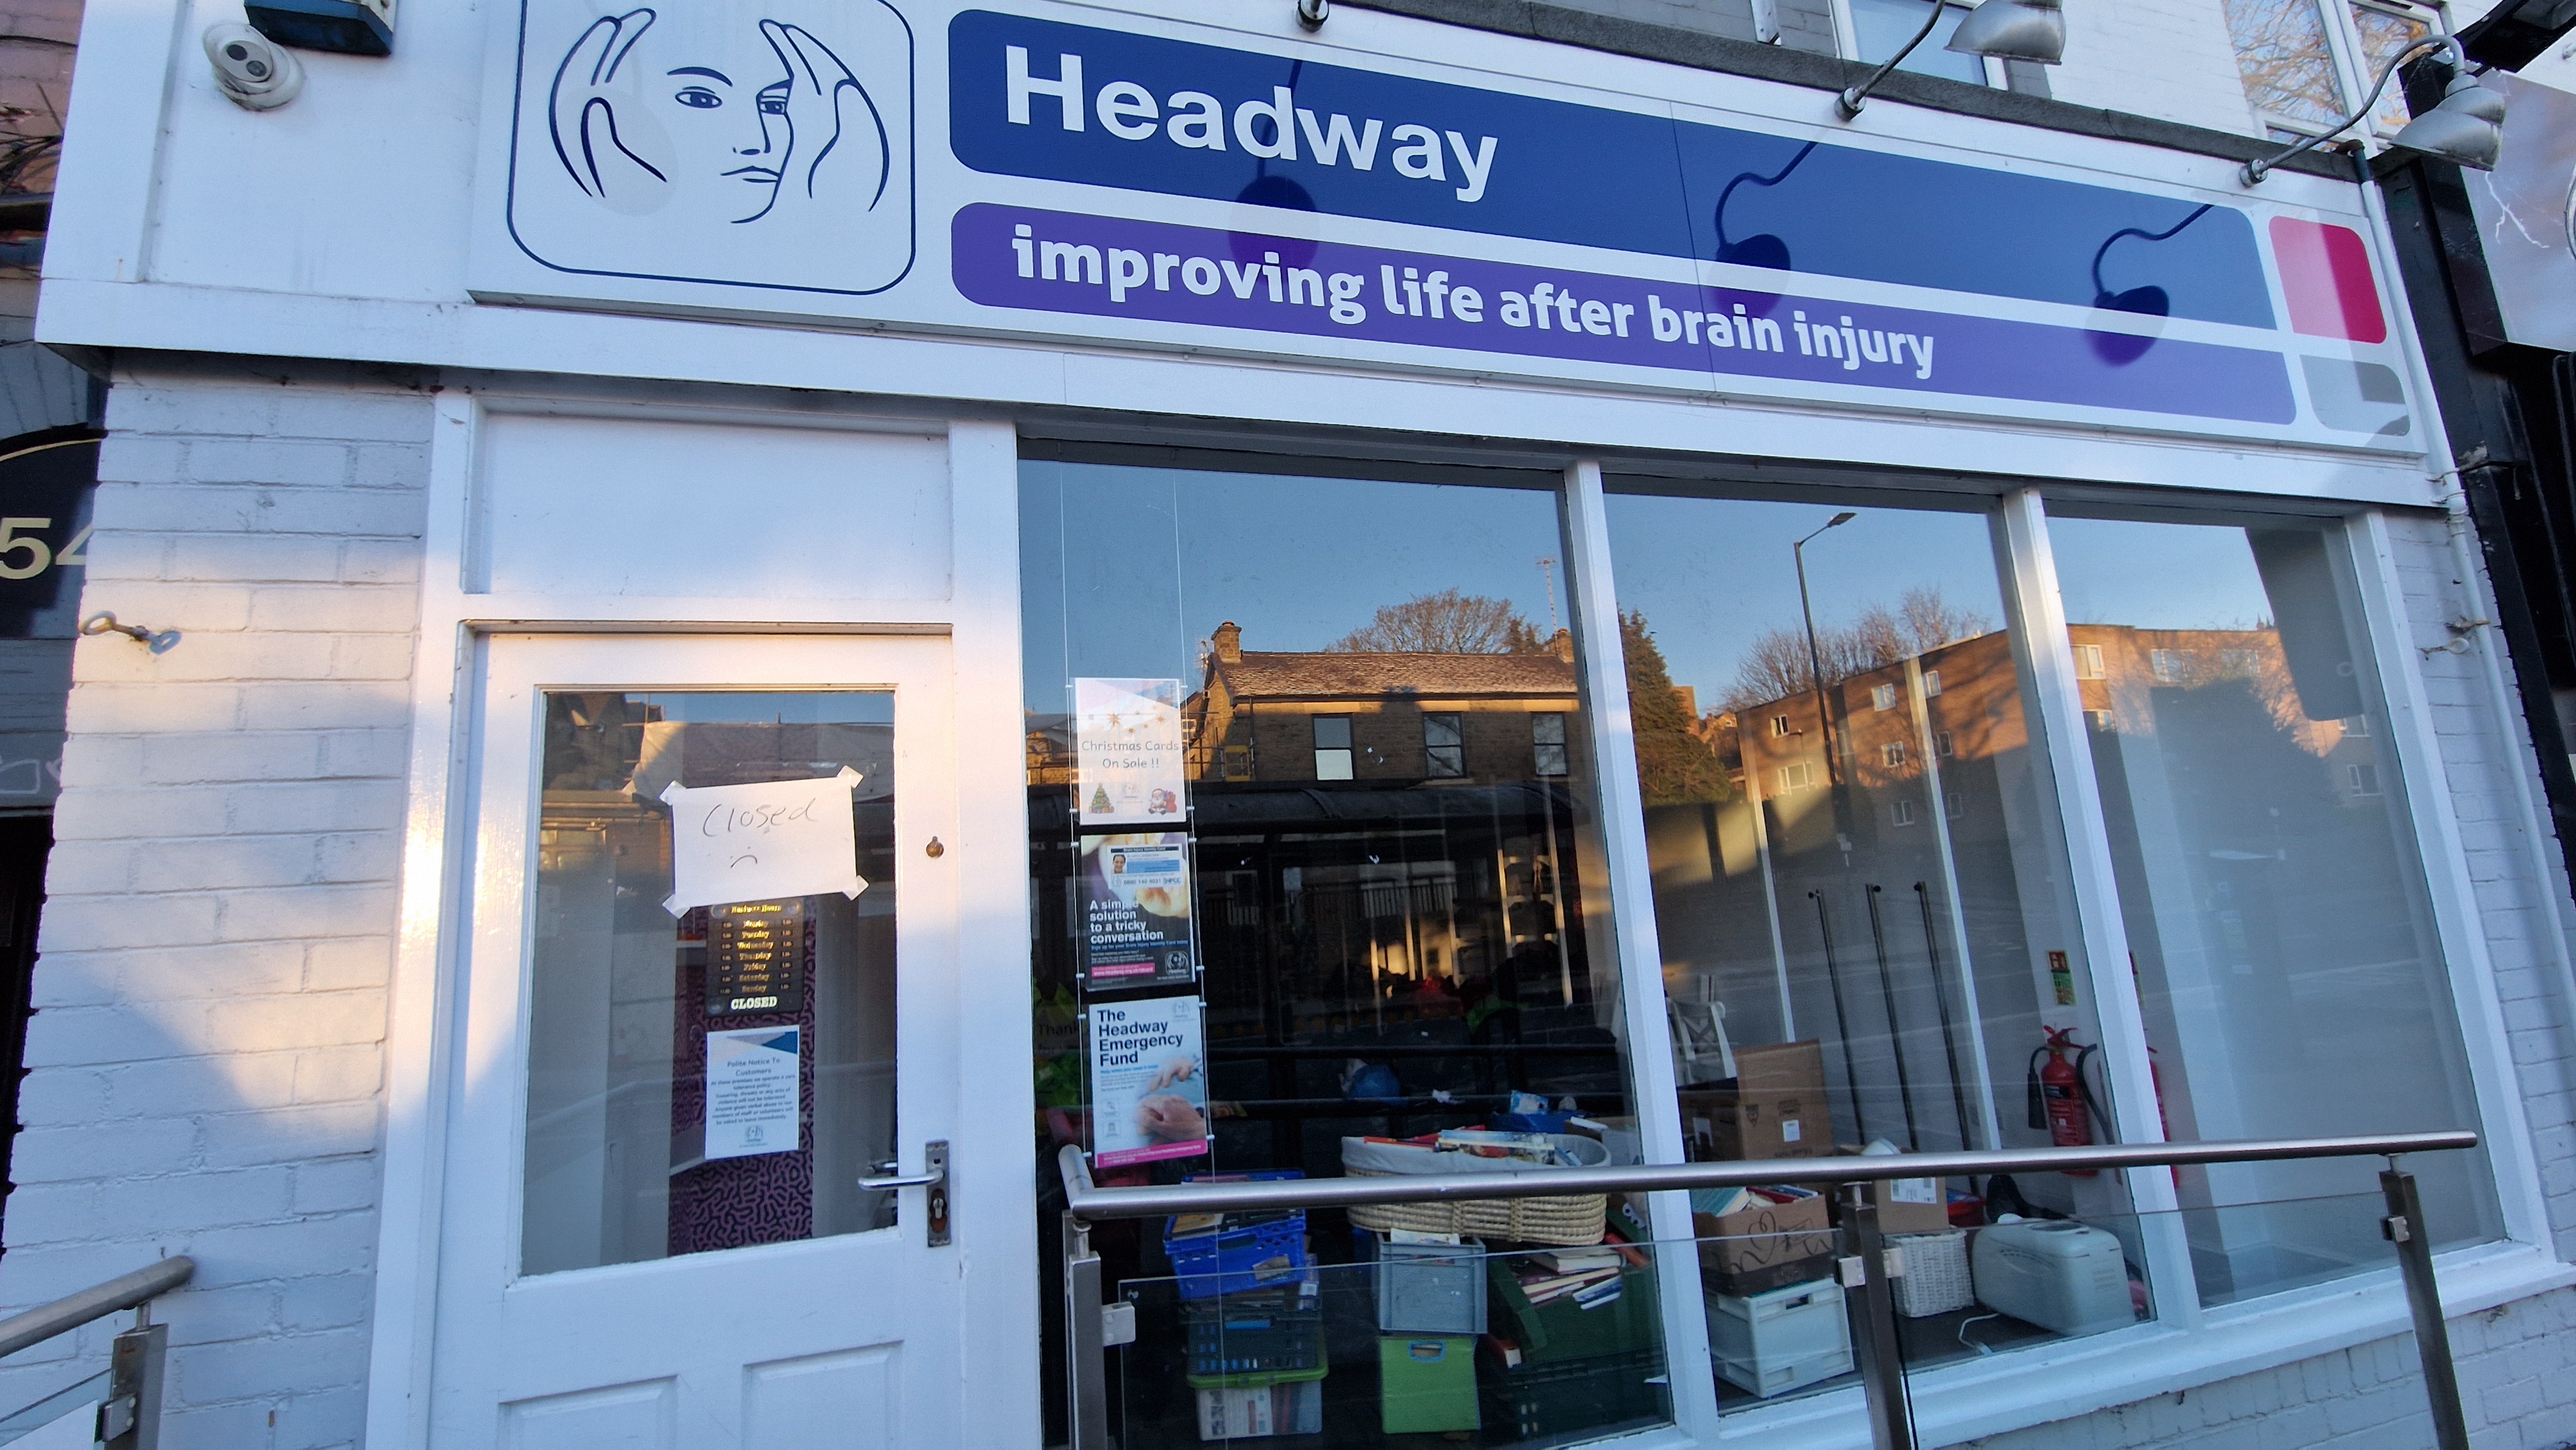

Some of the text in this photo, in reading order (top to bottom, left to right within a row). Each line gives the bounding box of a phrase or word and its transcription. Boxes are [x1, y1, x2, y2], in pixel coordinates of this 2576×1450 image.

[1004, 44, 1499, 203] Headway
[1010, 225, 1935, 380] improving life after brain injury
[1082, 740, 1179, 751] Christmas Cards
[1103, 758, 1159, 768] On Sale !!
[703, 798, 818, 837] Closed
[1090, 899, 1139, 912] A simpe
[1090, 910, 1137, 921] solution
[1090, 923, 1103, 932] to
[1115, 920, 1147, 932] tricky
[1091, 930, 1164, 945] conversation
[731, 996, 777, 1010] CLOSED
[1097, 1009, 1126, 1022] The
[1099, 1021, 1168, 1037] Headway
[1099, 1034, 1184, 1051] Emergency
[1100, 1051, 1139, 1067] Fund
